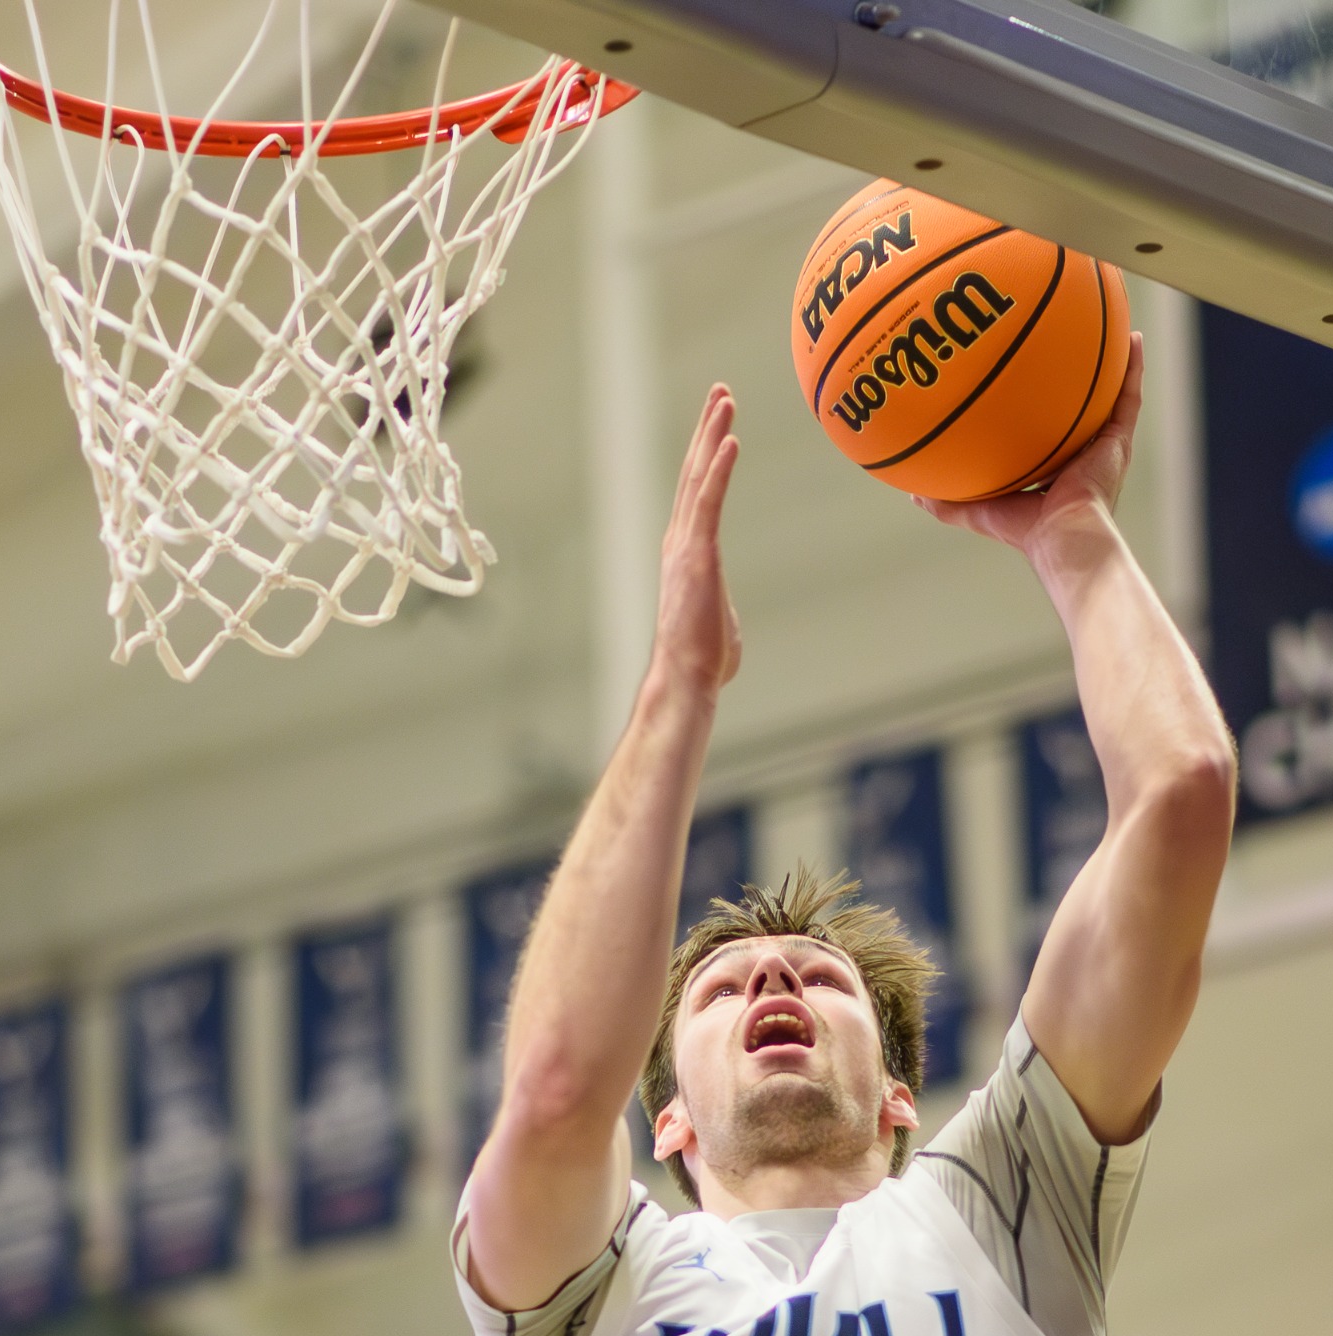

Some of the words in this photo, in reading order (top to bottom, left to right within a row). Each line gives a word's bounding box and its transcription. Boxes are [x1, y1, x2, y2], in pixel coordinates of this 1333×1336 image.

[801, 208, 918, 345] NCAA
[889, 300, 921, 333] INDOOR
[832, 271, 1016, 433] Wilson
[866, 333, 888, 357] GAME
[848, 356, 866, 374] BALL
